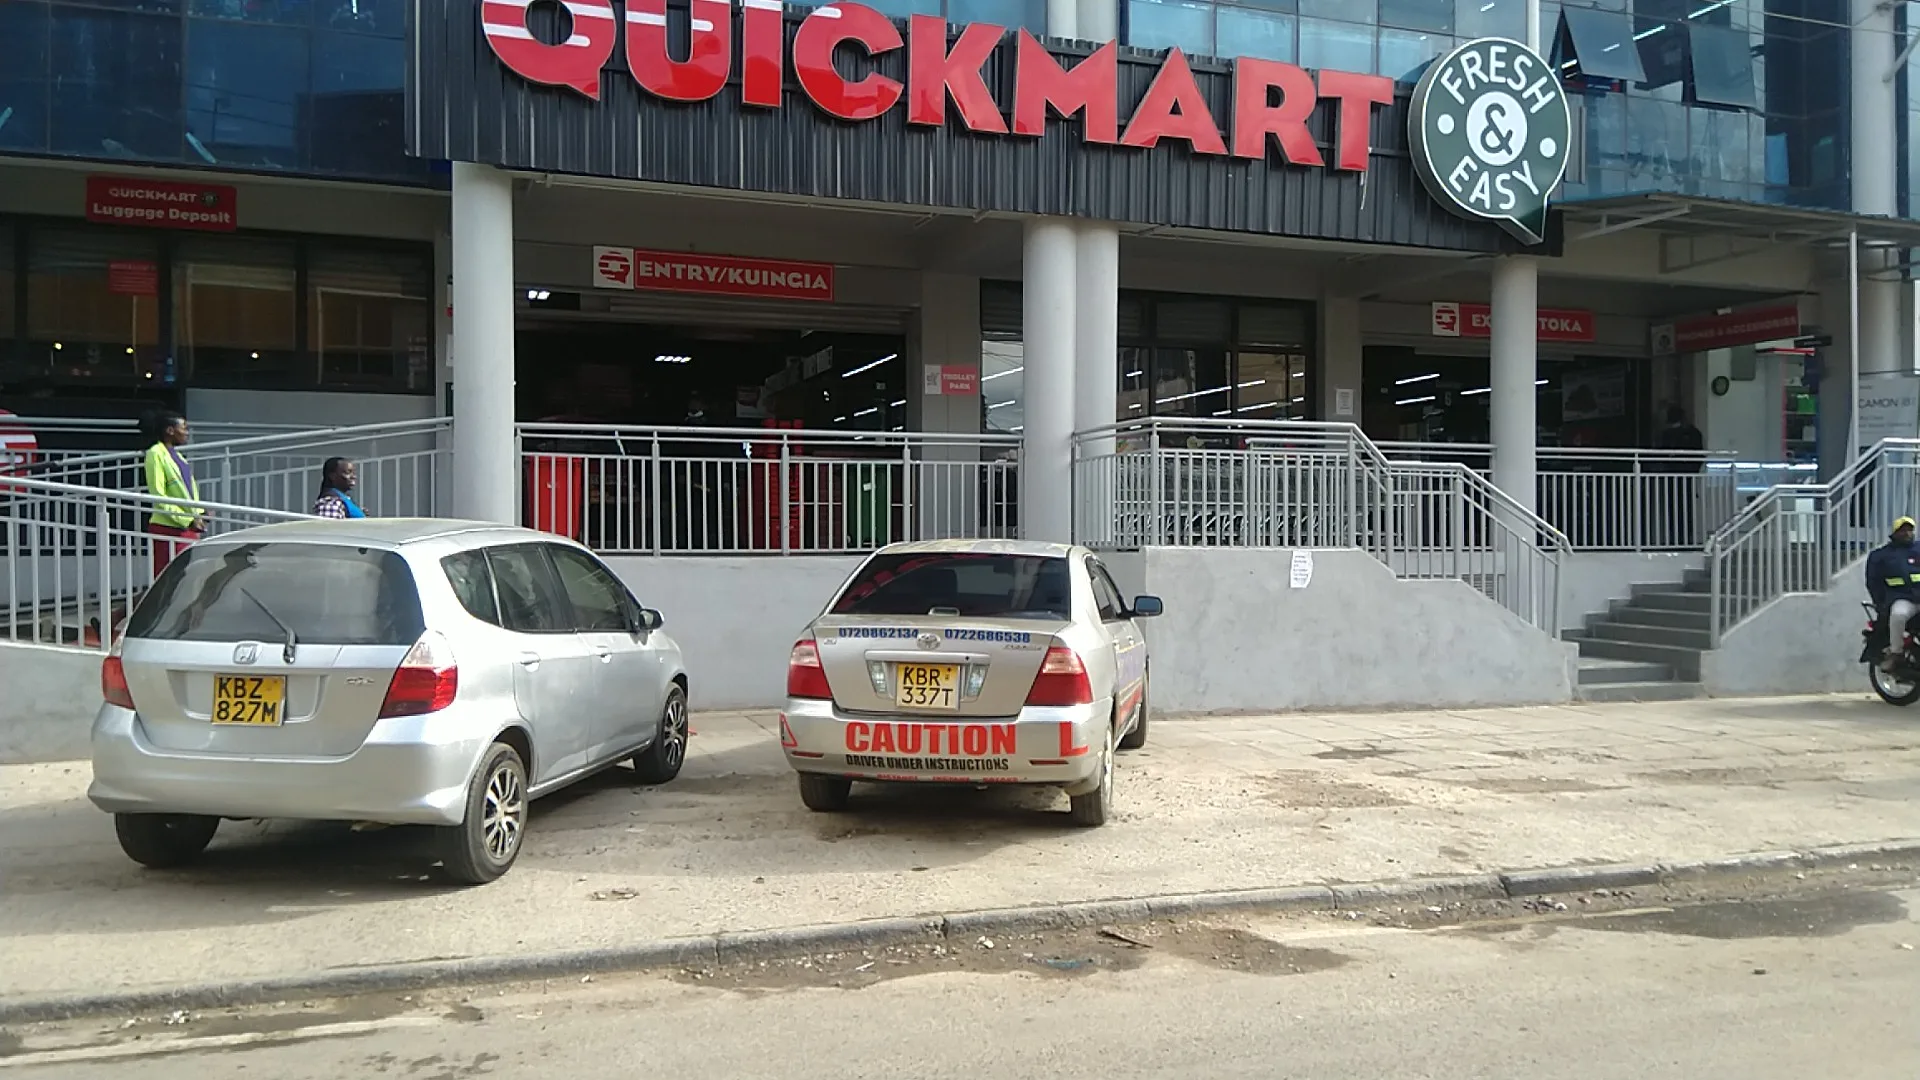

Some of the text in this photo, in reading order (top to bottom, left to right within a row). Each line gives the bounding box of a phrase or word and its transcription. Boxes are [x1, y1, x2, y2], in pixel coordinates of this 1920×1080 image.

[481, 0, 1394, 173] QUICKMART
[1440, 45, 1556, 114] FRESH
[1480, 102, 1514, 156] &
[1448, 155, 1540, 210] EASY
[108, 187, 198, 203] QUICKMART
[93, 202, 231, 224] Luggage Deposit
[639, 260, 828, 290] ENTRY/KUINGIA
[949, 382, 971, 390] PARK
[903, 666, 941, 686] KBR
[218, 677, 264, 698] KBZ
[901, 686, 954, 706] 337T
[216, 700, 277, 722] 827M
[845, 721, 1016, 756] CAUTION
[1059, 720, 1089, 757] L
[845, 753, 1009, 771] DRIVER UNDER INSTRUCTIONS
